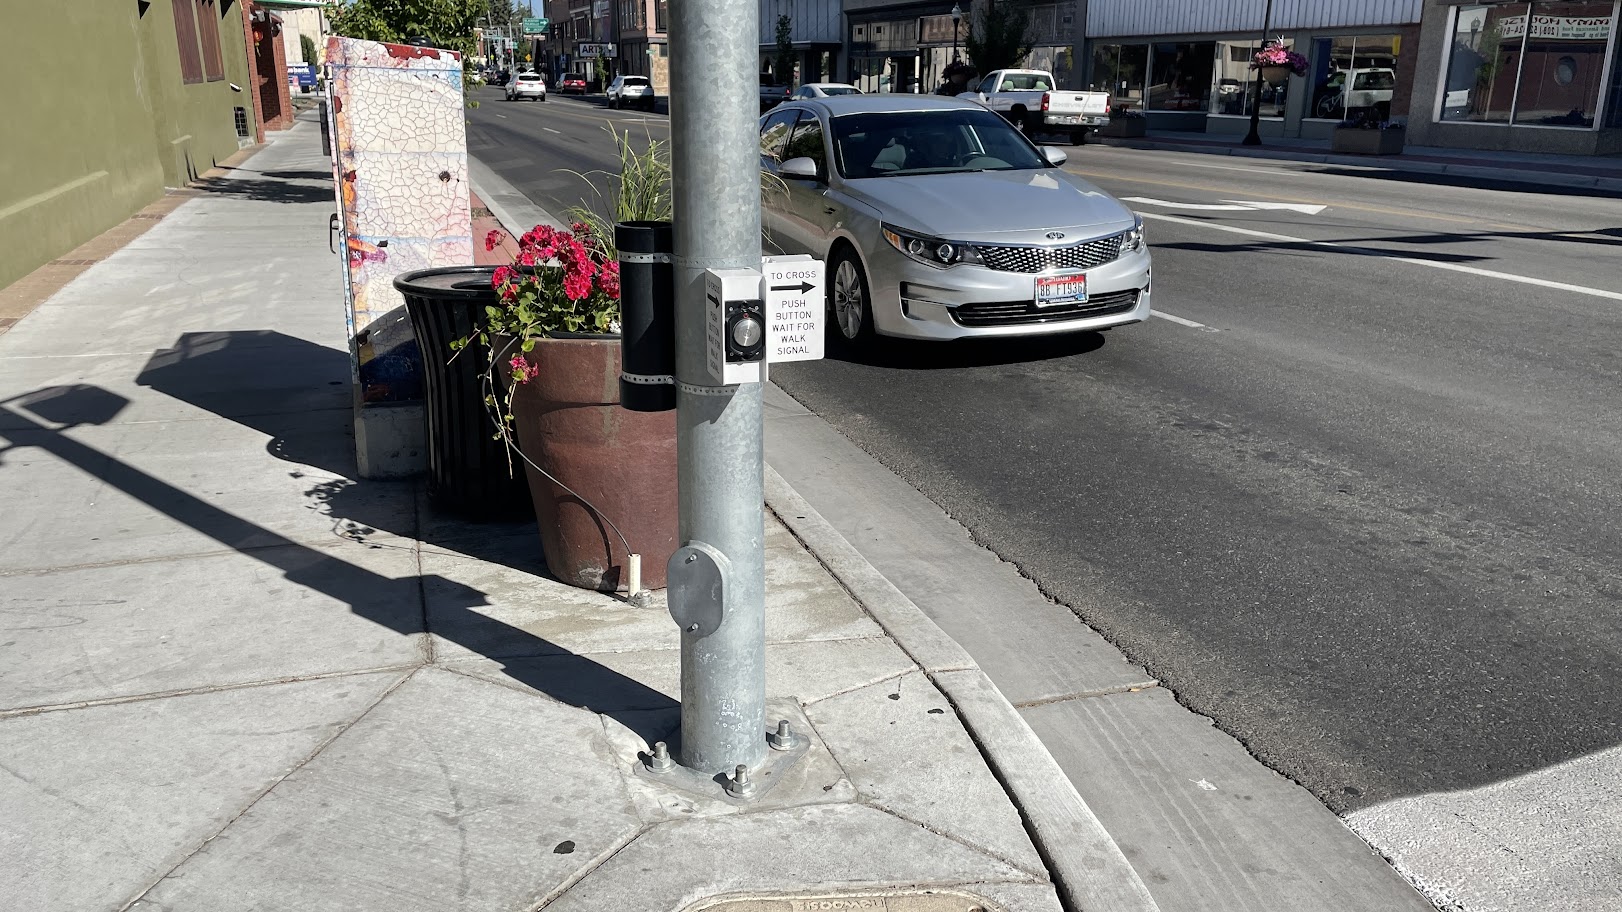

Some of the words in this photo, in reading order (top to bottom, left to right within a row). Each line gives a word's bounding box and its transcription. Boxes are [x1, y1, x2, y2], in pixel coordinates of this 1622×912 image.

[786, 271, 816, 279] CROSS
[1040, 284, 1050, 297] 8B
[1057, 282, 1082, 295] FT936
[782, 300, 806, 308] PUSH
[776, 311, 812, 320] BUTTON
[772, 324, 794, 332] WAIT
[798, 322, 815, 330] FOR
[781, 334, 806, 343] WALK
[778, 346, 809, 355] SIGNAL
